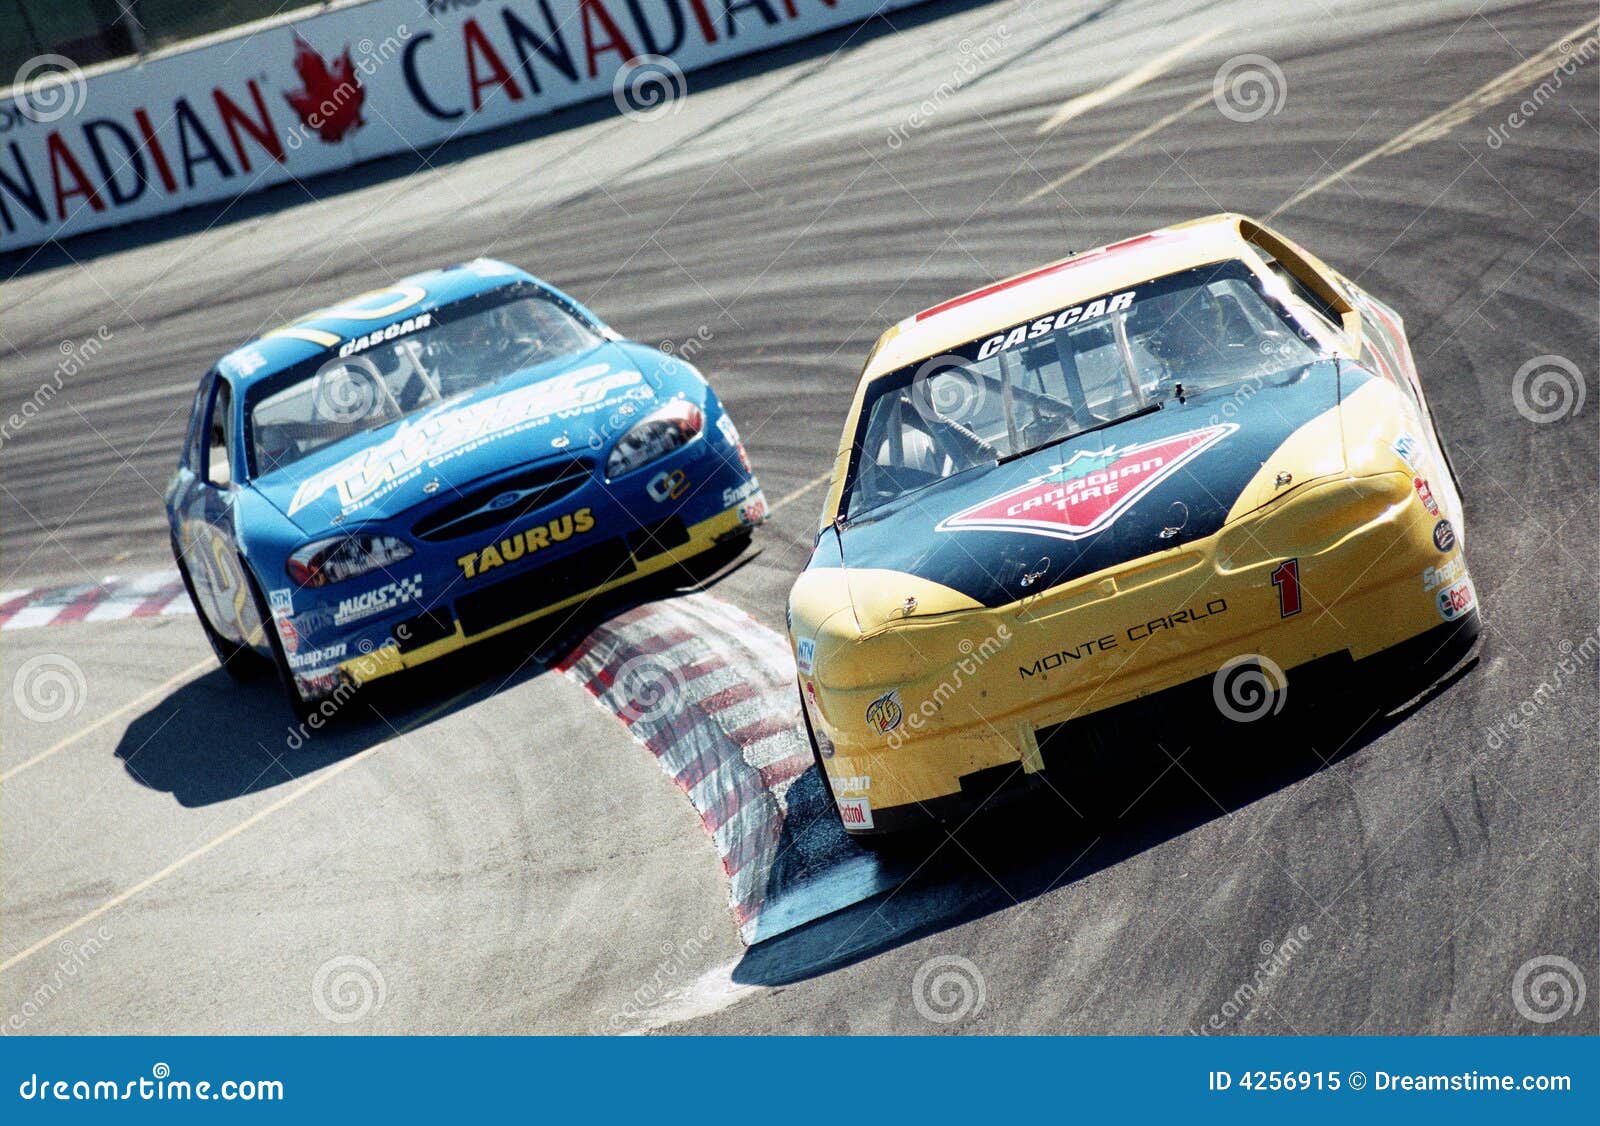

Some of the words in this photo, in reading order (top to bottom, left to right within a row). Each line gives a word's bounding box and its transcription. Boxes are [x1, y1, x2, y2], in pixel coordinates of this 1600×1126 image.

[402, 0, 838, 120] CANADI
[339, 313, 432, 358] CASCAR
[977, 290, 1137, 361] CASCAR
[1006, 456, 1164, 517] CANADIAN
[1051, 483, 1120, 511] TIRE
[457, 507, 596, 580] TAURUS
[338, 585, 389, 617] MICKS
[1271, 557, 1303, 620] 1
[288, 643, 348, 669] Snap-on
[1018, 633, 1119, 680] MONTE
[1127, 597, 1229, 643] CARLO
[832, 776, 870, 793] ap-on
[841, 804, 866, 824] astrol
